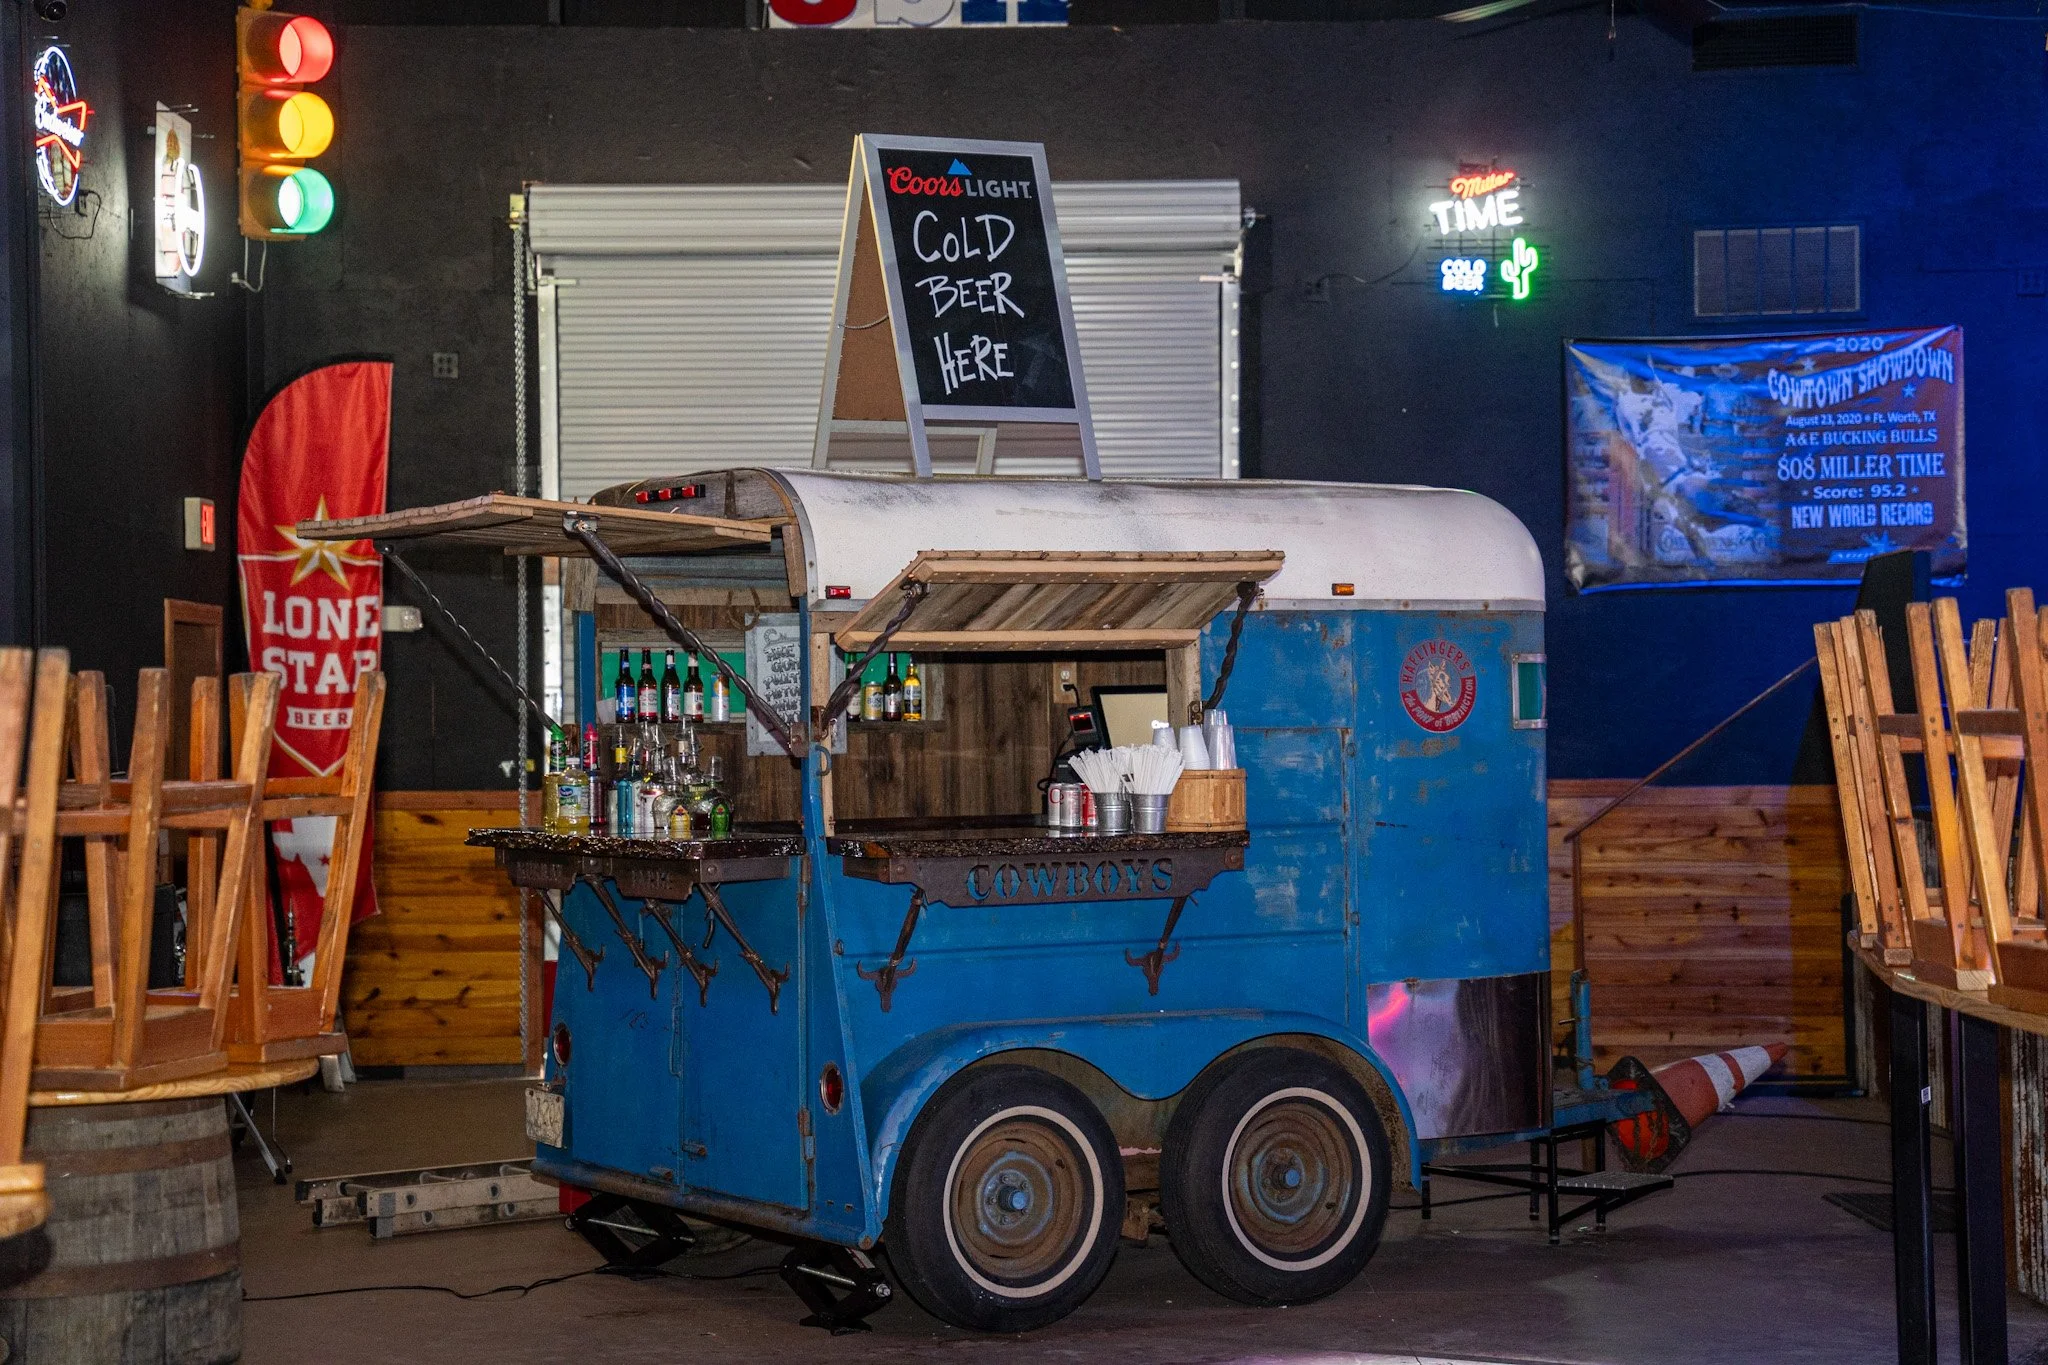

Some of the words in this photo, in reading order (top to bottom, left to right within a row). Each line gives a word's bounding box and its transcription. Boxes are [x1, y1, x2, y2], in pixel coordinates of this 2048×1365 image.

[887, 166, 964, 197] Coors
[965, 179, 1032, 199] LIGHT
[1451, 172, 1515, 200] Miller
[1428, 189, 1524, 235] TIME
[913, 209, 1015, 263] COLD
[1441, 259, 1487, 276] COLD
[915, 272, 1025, 318] BEER
[1442, 273, 1484, 291] BEER
[1835, 336, 1885, 352] 2020
[933, 332, 1014, 395] HERE
[1767, 368, 1854, 409] COWTOWN
[1858, 347, 1955, 395] SHOWDOWN
[1785, 414, 1819, 428] August
[1820, 413, 1835, 427] 23,
[1836, 413, 1863, 425] 2020
[1873, 412, 1886, 424] Ft.
[1887, 412, 1921, 424] Worth,
[1922, 410, 1937, 422] TX
[1785, 431, 1820, 447] A&E
[1822, 430, 1887, 446] BUCKING
[1890, 428, 1938, 444] BULLS
[1820, 454, 1893, 480] MILLER
[1896, 452, 1946, 477] TIME
[1813, 485, 1864, 499] Score:
[1870, 484, 1907, 498] 95.2
[1791, 504, 1824, 529] NEW
[1828, 503, 1877, 528] WORLD
[1880, 502, 1935, 526] RECORD
[262, 590, 379, 641] LONE
[262, 646, 378, 695] STAR
[294, 712, 348, 726] BEER
[965, 858, 1174, 901] COWBOYS
